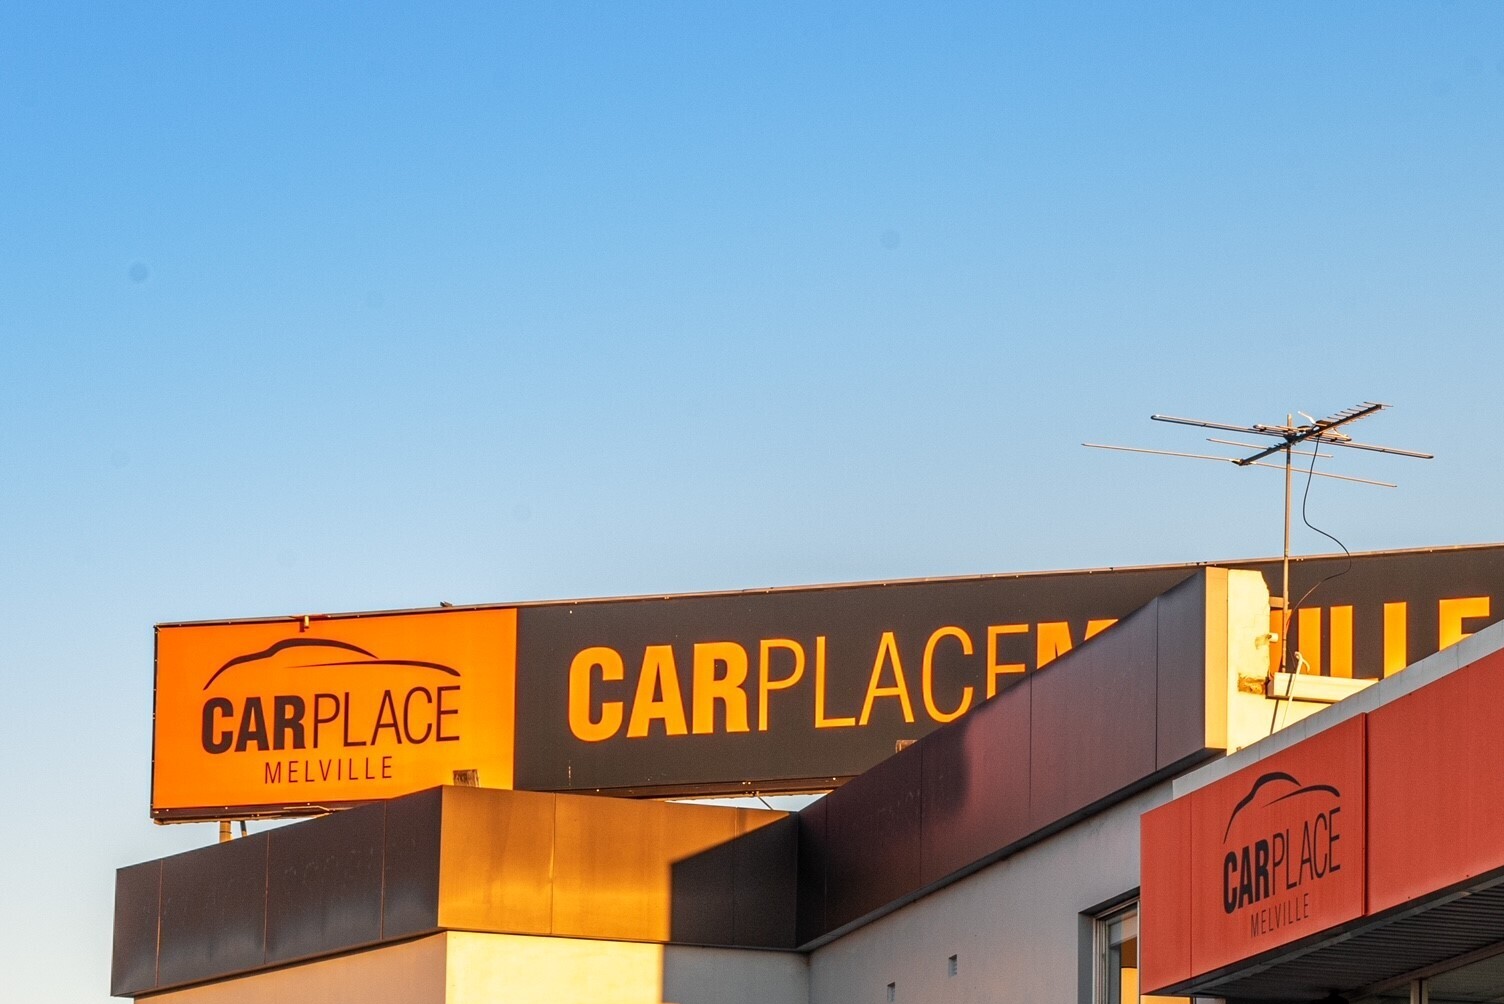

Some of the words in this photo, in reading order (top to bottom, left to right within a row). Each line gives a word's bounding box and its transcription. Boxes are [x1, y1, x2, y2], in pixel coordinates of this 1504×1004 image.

[202, 685, 461, 754] CARPLACE
[265, 756, 392, 784] MELVILLE
[1223, 806, 1341, 914] CARPLACE
[1251, 893, 1309, 938] MELVILLE
